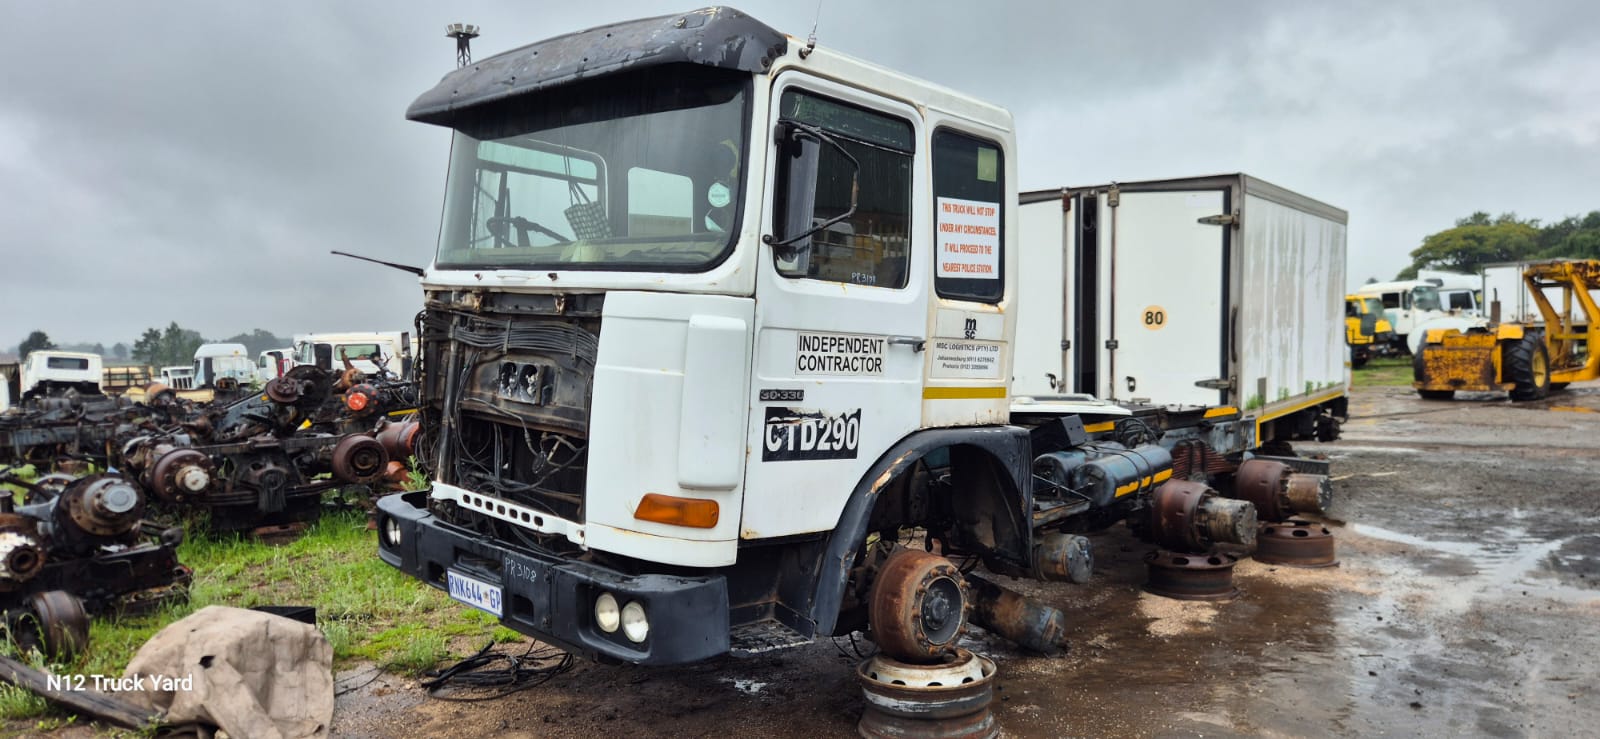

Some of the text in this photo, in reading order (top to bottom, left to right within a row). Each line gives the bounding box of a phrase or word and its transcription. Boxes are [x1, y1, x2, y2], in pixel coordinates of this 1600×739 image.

[942, 203, 951, 213] THIS
[952, 204, 965, 214] TRUCK
[966, 205, 975, 215] WILL
[985, 207, 995, 216] STOP
[940, 223, 954, 233] UNDER
[954, 224, 963, 234] ANY
[944, 243, 949, 252] IT
[949, 243, 959, 253] WILL
[960, 244, 978, 254] PROCEED
[979, 245, 984, 254] TO
[943, 262, 961, 272] NEAREST
[962, 263, 976, 273] POLICE
[1145, 311, 1164, 325] 80
[799, 335, 884, 354] INDEPENDENT
[949, 343, 975, 351] LOGISTICS
[798, 355, 882, 373] CONTRACTOR
[765, 416, 859, 452] CTD290
[504, 557, 537, 583] PR3108
[448, 575, 501, 610] RNK644 GP
